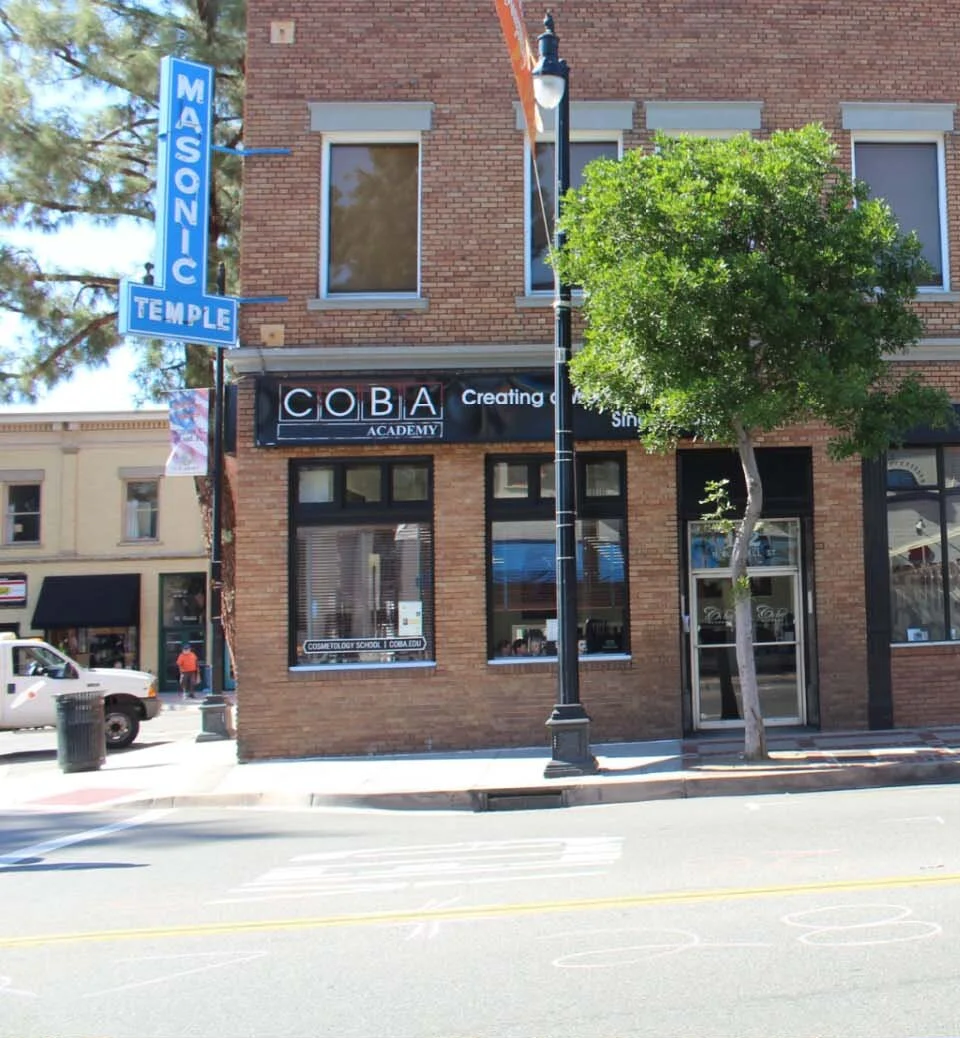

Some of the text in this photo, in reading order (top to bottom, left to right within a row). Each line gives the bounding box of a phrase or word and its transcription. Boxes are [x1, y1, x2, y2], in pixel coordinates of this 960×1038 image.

[172, 73, 205, 285] MASONIC
[133, 295, 231, 332] TEMPLE
[283, 386, 438, 418] COBA
[461, 388, 544, 408] Creating
[366, 424, 439, 437] ACADEMY
[307, 639, 422, 651] COSMETOLOGY SCHOOL COBA.EDU
